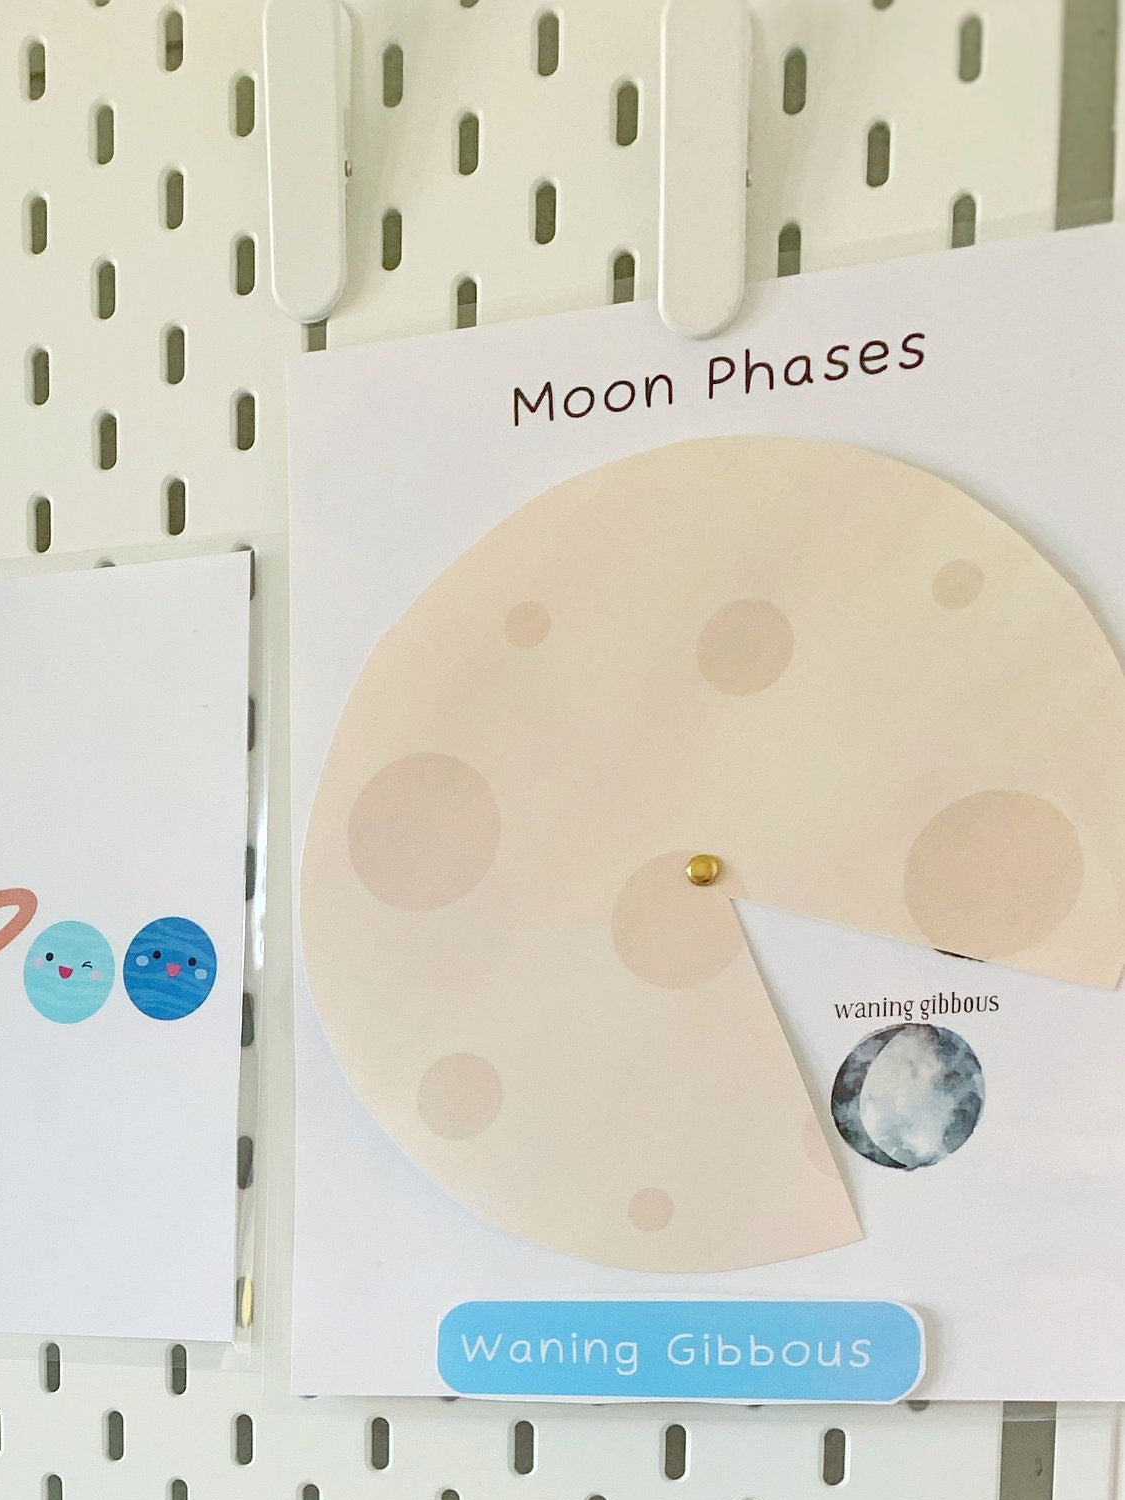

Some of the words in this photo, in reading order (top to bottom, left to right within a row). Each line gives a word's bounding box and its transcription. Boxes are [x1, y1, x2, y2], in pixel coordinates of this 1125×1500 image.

[513, 372, 674, 428] Moon
[707, 331, 927, 400] Phases
[833, 996, 914, 1021] waning
[919, 991, 1001, 1021] gibbous
[460, 1331, 639, 1376] Waning
[666, 1331, 873, 1369] Gibbous
